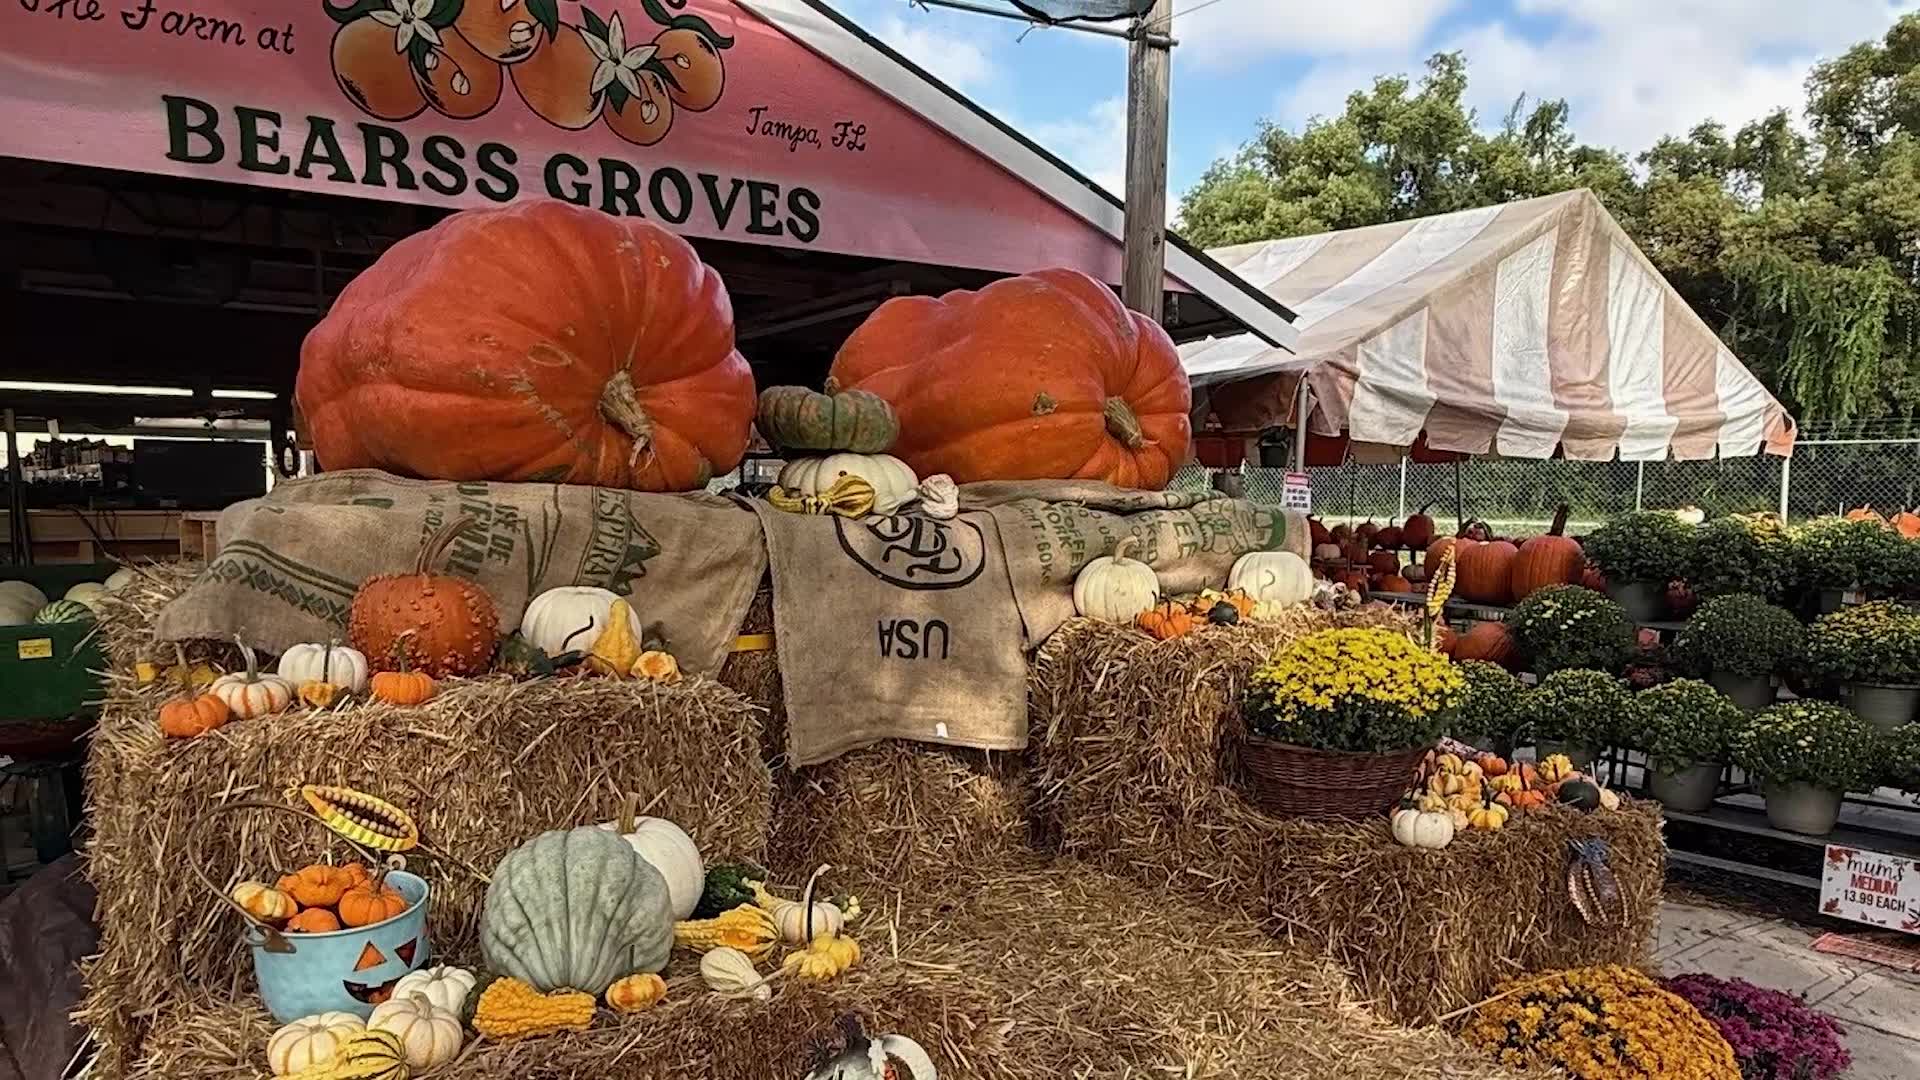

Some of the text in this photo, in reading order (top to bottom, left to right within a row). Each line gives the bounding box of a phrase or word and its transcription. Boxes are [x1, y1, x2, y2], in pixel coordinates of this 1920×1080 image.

[121, 0, 246, 46] Farm
[256, 24, 296, 54] at
[746, 106, 867, 152] Tampa, FL
[162, 94, 821, 243] BEARSS GROVES
[878, 619, 949, 660] USA
[1847, 856, 1905, 881] mums
[1850, 873, 1898, 896] MEDIUM
[1844, 889, 1906, 912] 13.99 EACH
